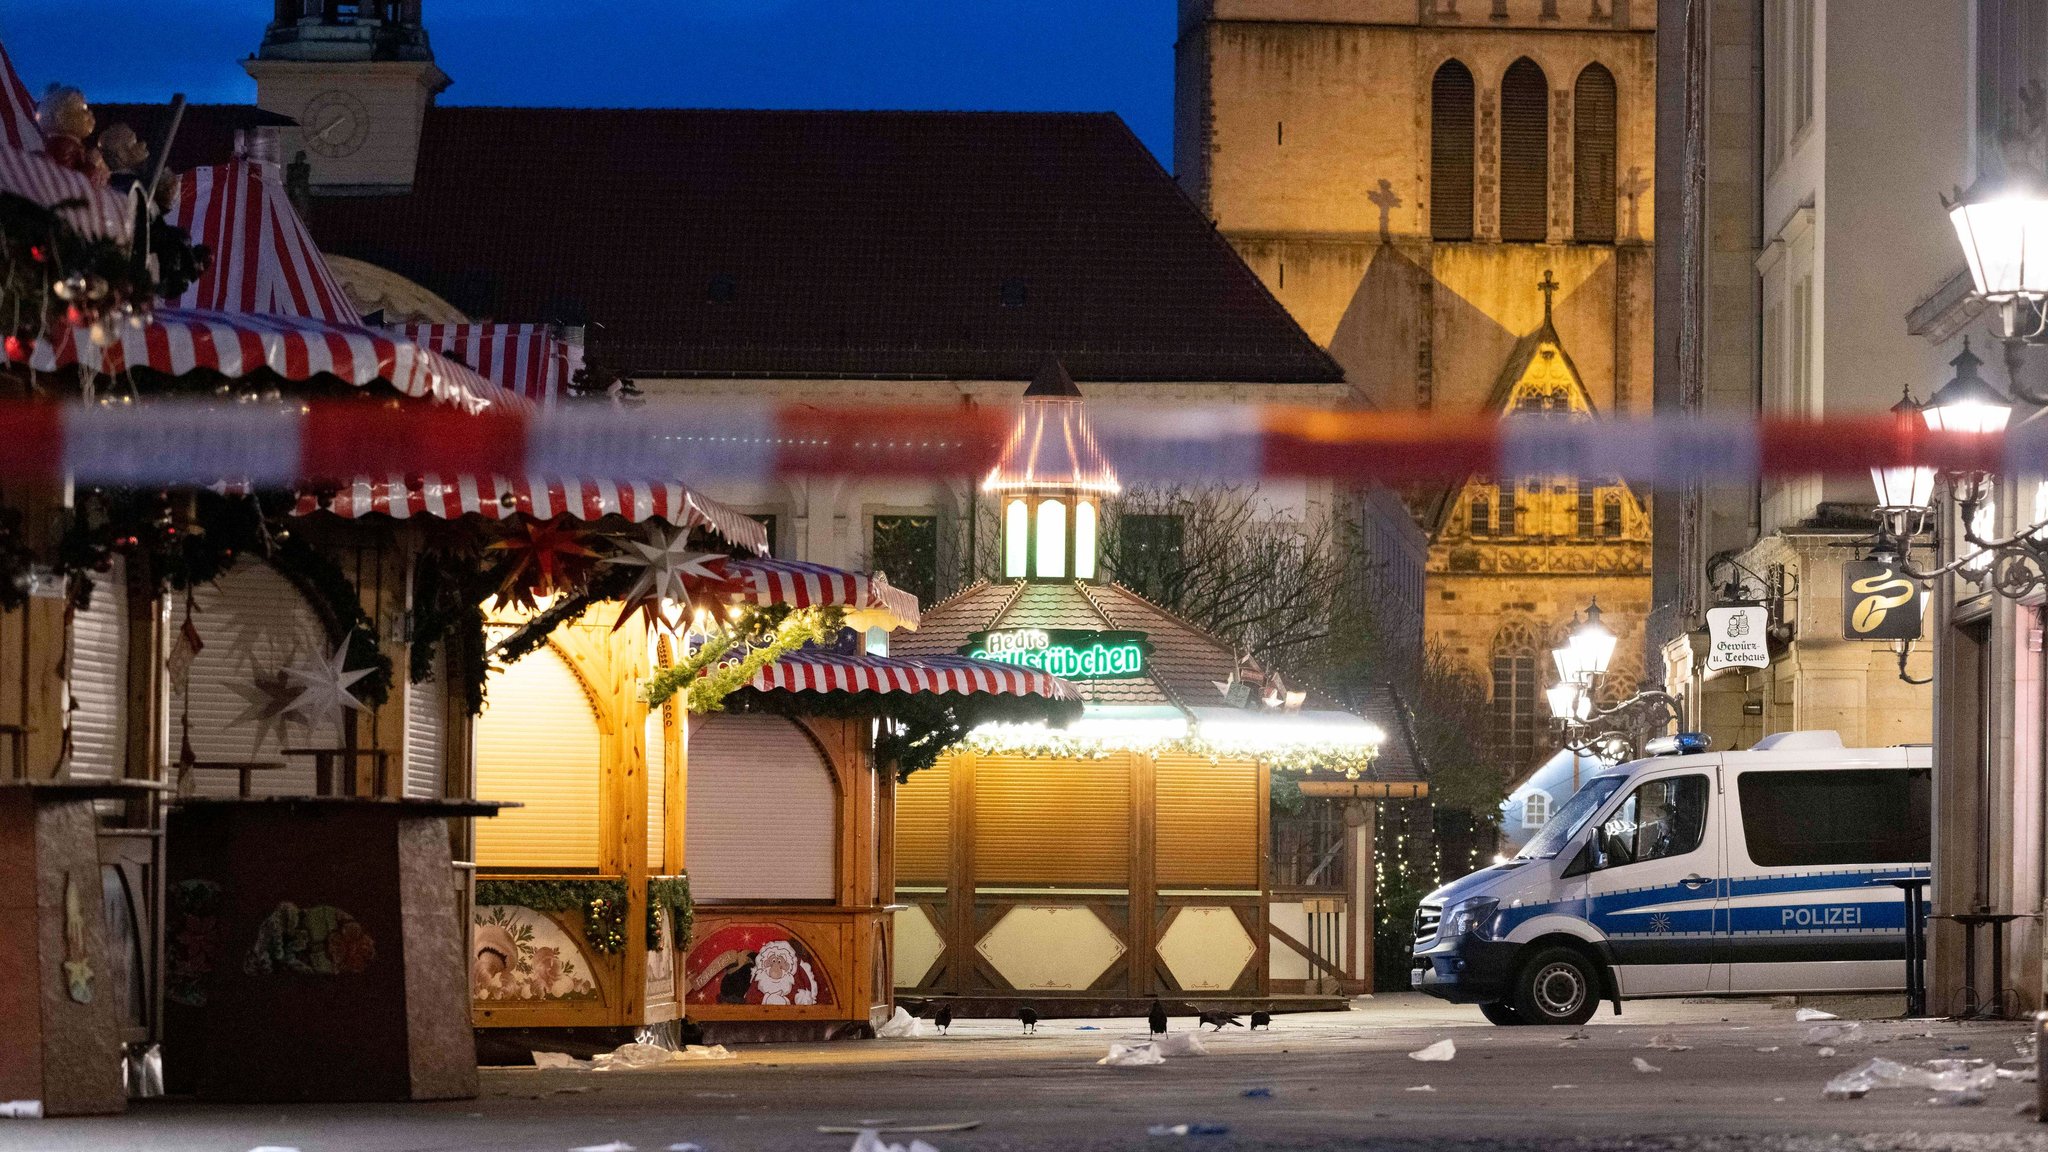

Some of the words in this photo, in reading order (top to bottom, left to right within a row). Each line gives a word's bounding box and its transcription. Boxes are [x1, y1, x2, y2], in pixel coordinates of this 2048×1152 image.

[1717, 641, 1760, 651] Gewürz-
[971, 644, 1142, 677] llstübchen
[1725, 652, 1765, 663] Teehaus
[1782, 907, 1861, 926] POLIZEI
